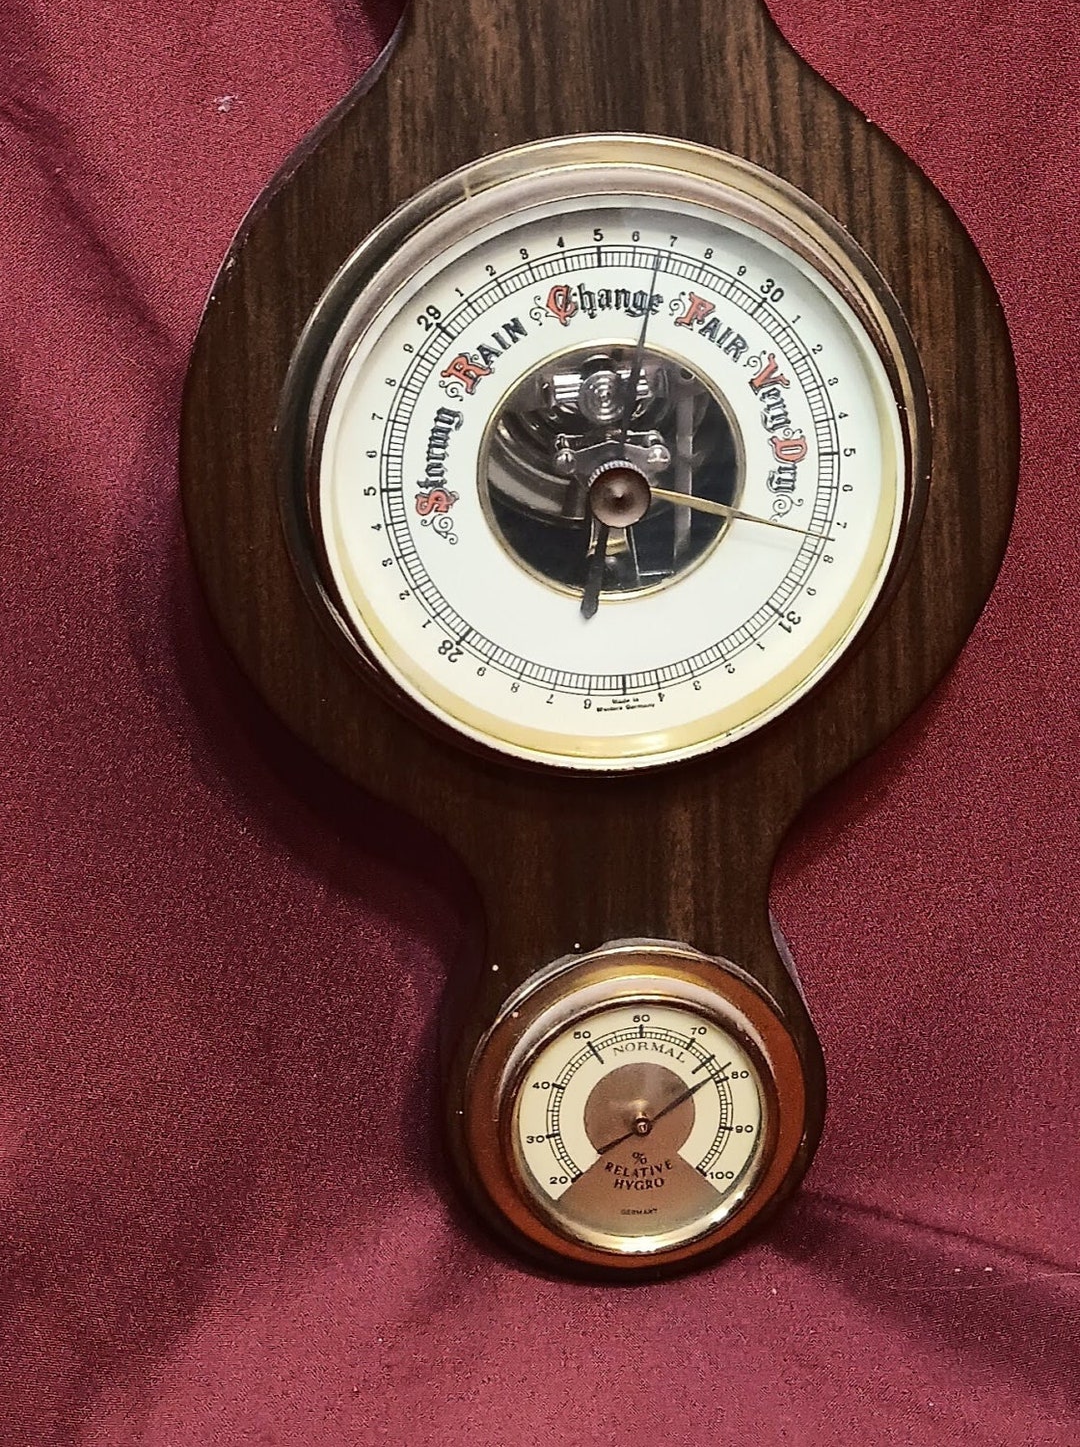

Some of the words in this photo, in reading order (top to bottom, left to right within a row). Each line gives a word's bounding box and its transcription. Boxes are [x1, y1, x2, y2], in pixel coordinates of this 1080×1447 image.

[593, 229, 604, 242] 5
[632, 231, 640, 242] 6
[669, 235, 678, 247] 7
[557, 236, 565, 248] 4
[519, 248, 529, 260] 3
[704, 248, 714, 260] 8
[485, 264, 497, 277] 2
[737, 265, 747, 277] 9
[455, 287, 465, 298] 1
[760, 278, 785, 303] 30
[546, 282, 663, 327] Change
[417, 305, 441, 331] 29
[792, 314, 801, 324] 1
[674, 291, 748, 363] FAIR
[403, 343, 414, 353] 9
[812, 343, 823, 355] 2
[440, 317, 528, 395] RAIN
[385, 377, 397, 387] 8
[827, 376, 839, 386] 3
[748, 353, 791, 432] Very
[371, 412, 384, 421] 7
[838, 411, 849, 419] 4
[366, 449, 378, 458] 6
[843, 447, 856, 457] 5
[414, 407, 464, 516] Stormy
[766, 435, 808, 493] Dry
[364, 486, 377, 496] 5
[842, 484, 853, 492] 6
[371, 523, 382, 531] 4
[836, 521, 847, 529] 7
[382, 557, 393, 567] 3
[823, 554, 834, 564] 8
[399, 589, 410, 600] 2
[806, 586, 817, 597] 9
[421, 619, 432, 629] 1
[778, 610, 802, 634] 31
[438, 639, 464, 663] 28
[756, 641, 765, 651] 1
[476, 666, 487, 677] 9
[724, 663, 736, 674] 2
[510, 682, 520, 693] 8
[692, 680, 702, 691] 3
[546, 694, 554, 705] 7
[658, 692, 665, 702] 4
[583, 698, 592, 709] 6
[632, 1014, 651, 1023] 60
[573, 1030, 591, 1040] 50
[690, 1026, 707, 1035] 70
[613, 1042, 685, 1063] NORMAL
[731, 1070, 749, 1079] 80
[532, 1080, 550, 1090] 40
[735, 1124, 753, 1133] 90
[526, 1134, 545, 1143] 30
[604, 1159, 673, 1178] RELATIVE
[549, 1175, 568, 1185] 20
[709, 1170, 735, 1180] 100
[613, 1177, 665, 1191] HYGRO
